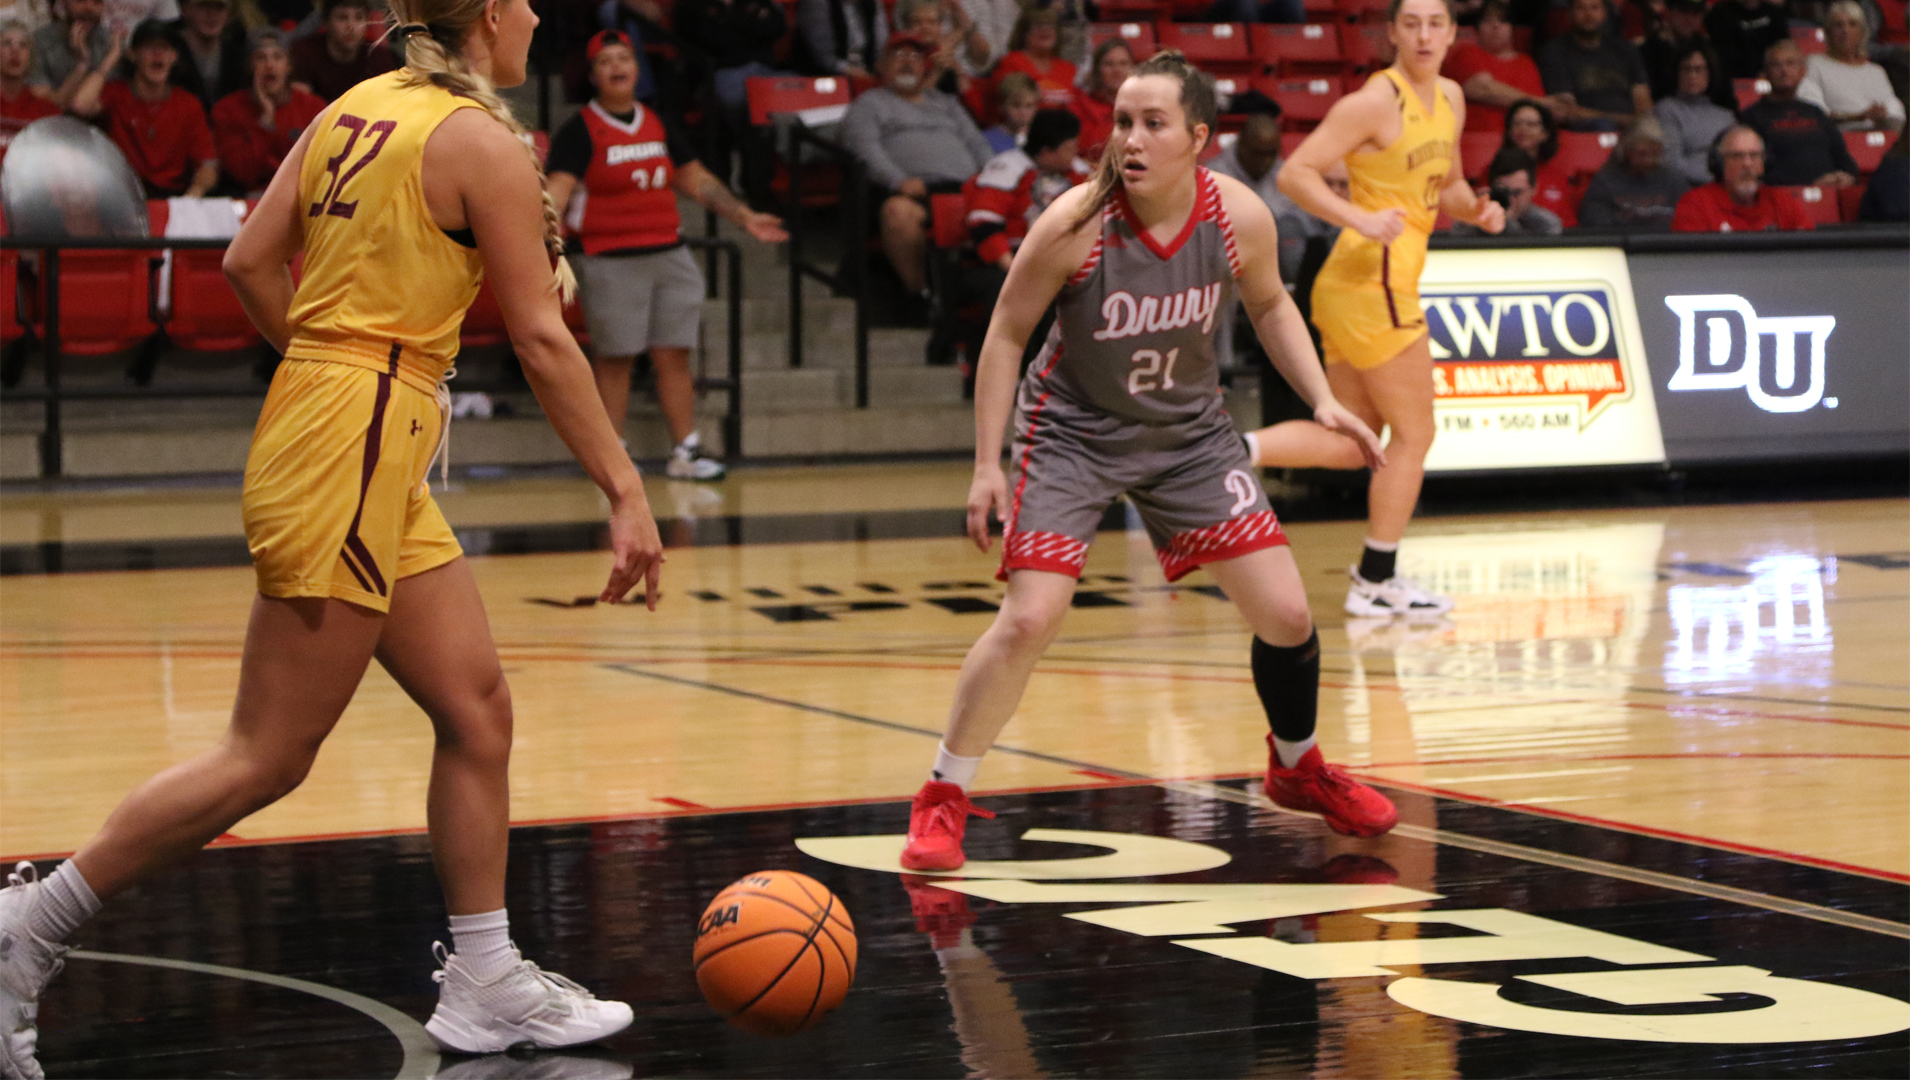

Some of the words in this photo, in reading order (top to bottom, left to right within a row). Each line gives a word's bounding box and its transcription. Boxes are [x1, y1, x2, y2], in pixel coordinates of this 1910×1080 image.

[308, 113, 398, 219] 32
[1093, 282, 1222, 341] Drury
[1128, 346, 1180, 395] 21
[1542, 411, 1572, 428] AM
